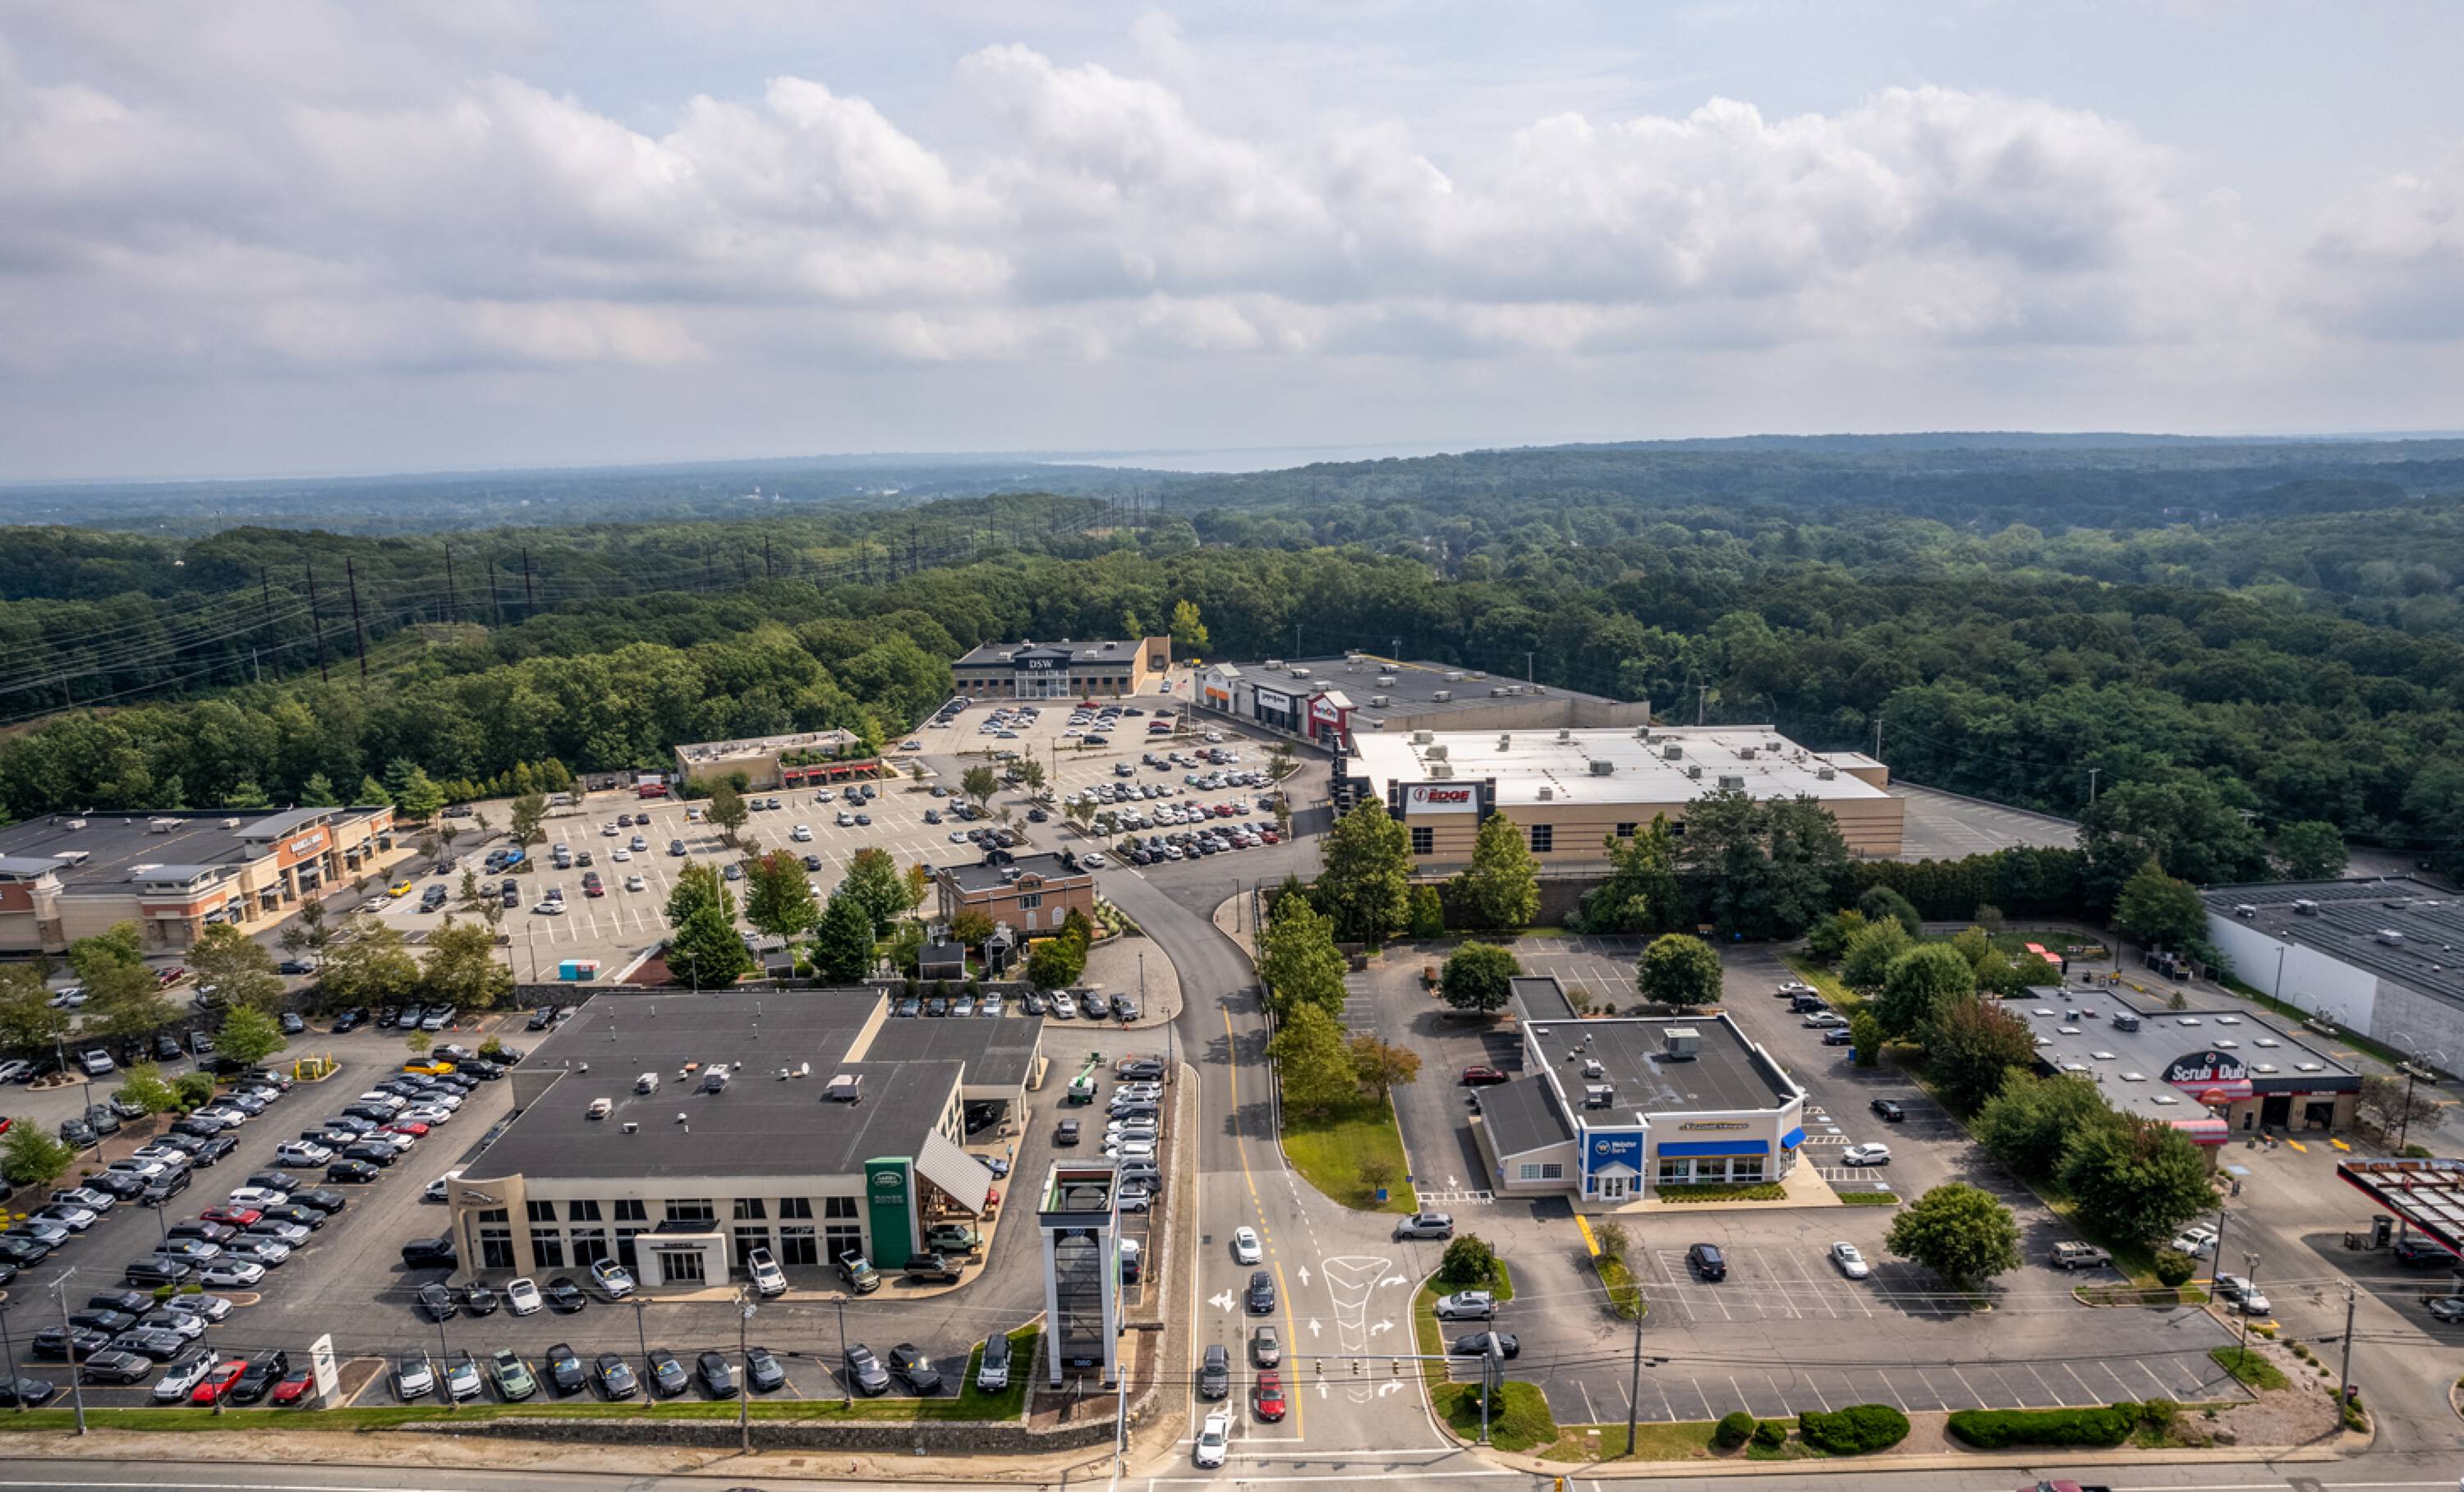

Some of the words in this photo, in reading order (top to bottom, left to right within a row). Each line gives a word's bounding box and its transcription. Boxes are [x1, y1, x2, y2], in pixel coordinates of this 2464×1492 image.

[1029, 659, 1053, 668] DSW
[1427, 791, 1470, 801] EDGE
[2172, 1065, 2211, 1081] Scrub
[2219, 1064, 2245, 1080] Dub
